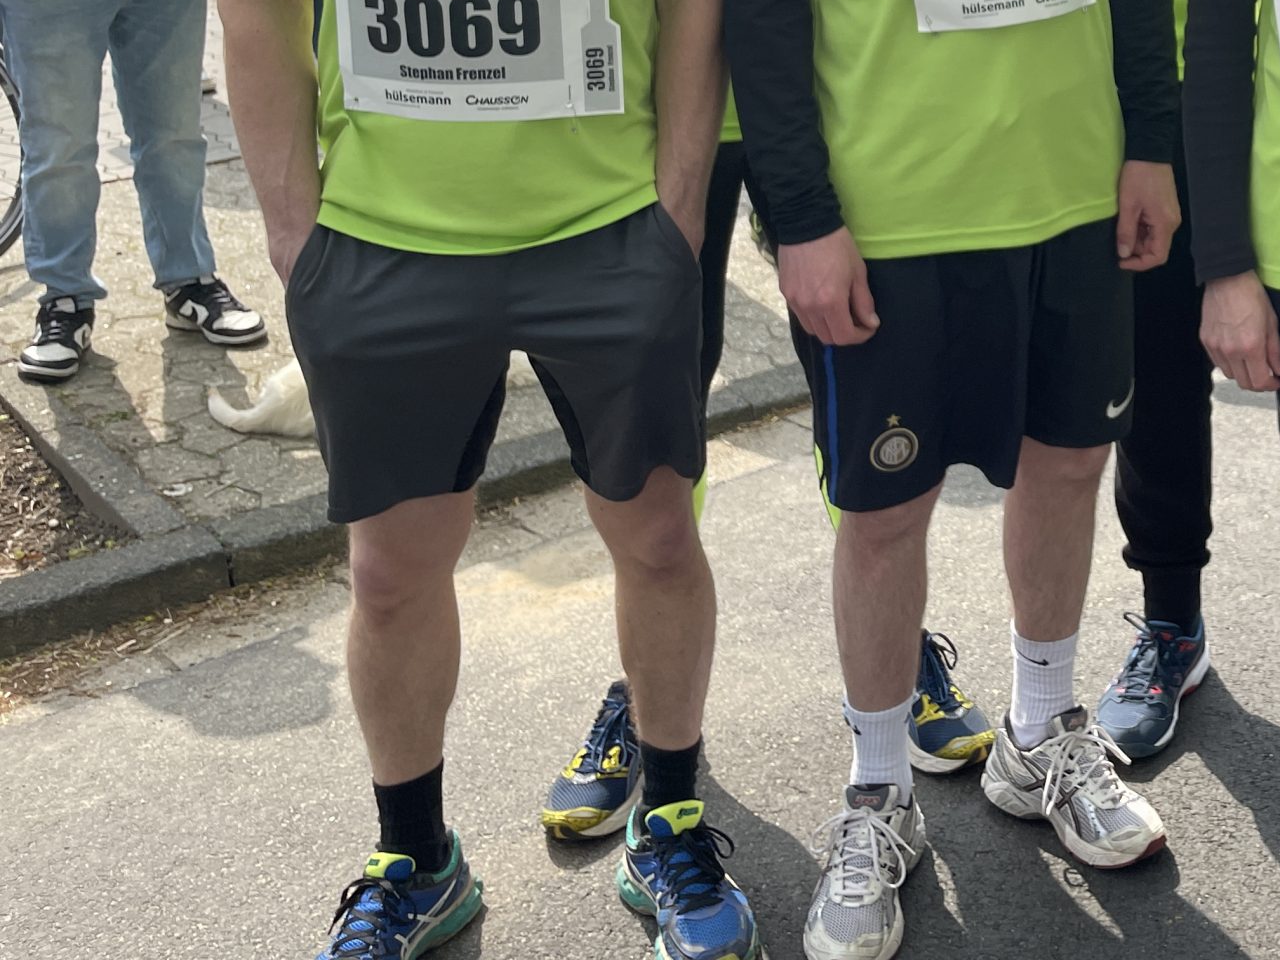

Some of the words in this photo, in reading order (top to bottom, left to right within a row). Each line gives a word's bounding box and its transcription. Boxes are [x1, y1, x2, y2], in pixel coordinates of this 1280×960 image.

[400, 65, 454, 81] Stephan
[456, 66, 506, 80] Frenzel
[586, 48, 605, 91] 3069
[385, 89, 451, 106] hülsemann
